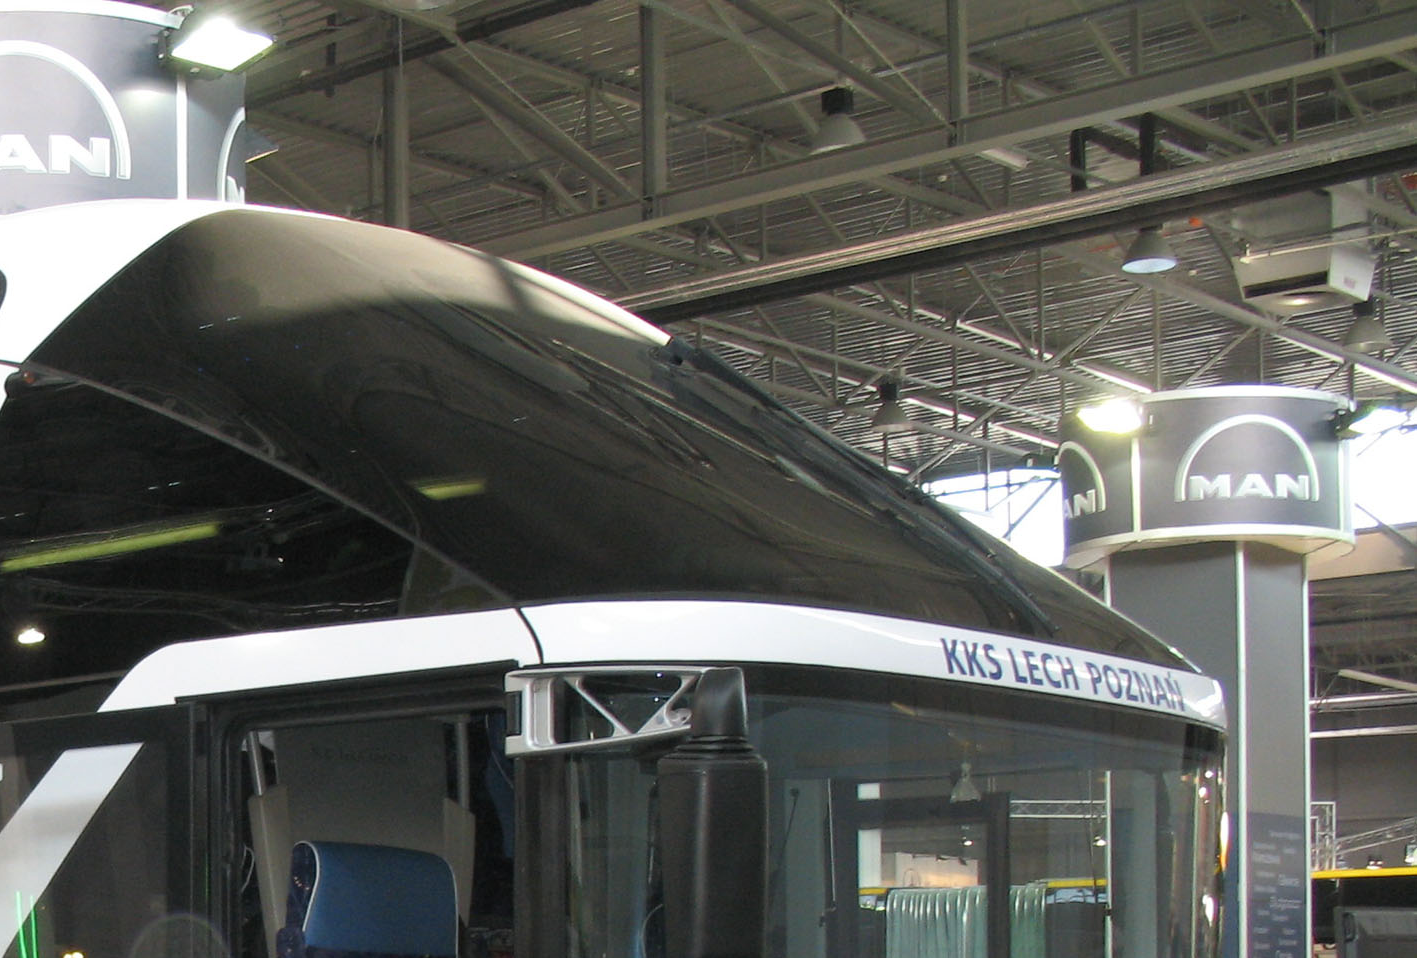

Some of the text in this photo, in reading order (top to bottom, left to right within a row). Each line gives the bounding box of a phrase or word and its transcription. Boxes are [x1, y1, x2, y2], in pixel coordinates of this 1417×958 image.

[1188, 473, 1310, 500] MAN
[940, 638, 1186, 712] KKS LECH POZNAŃ
